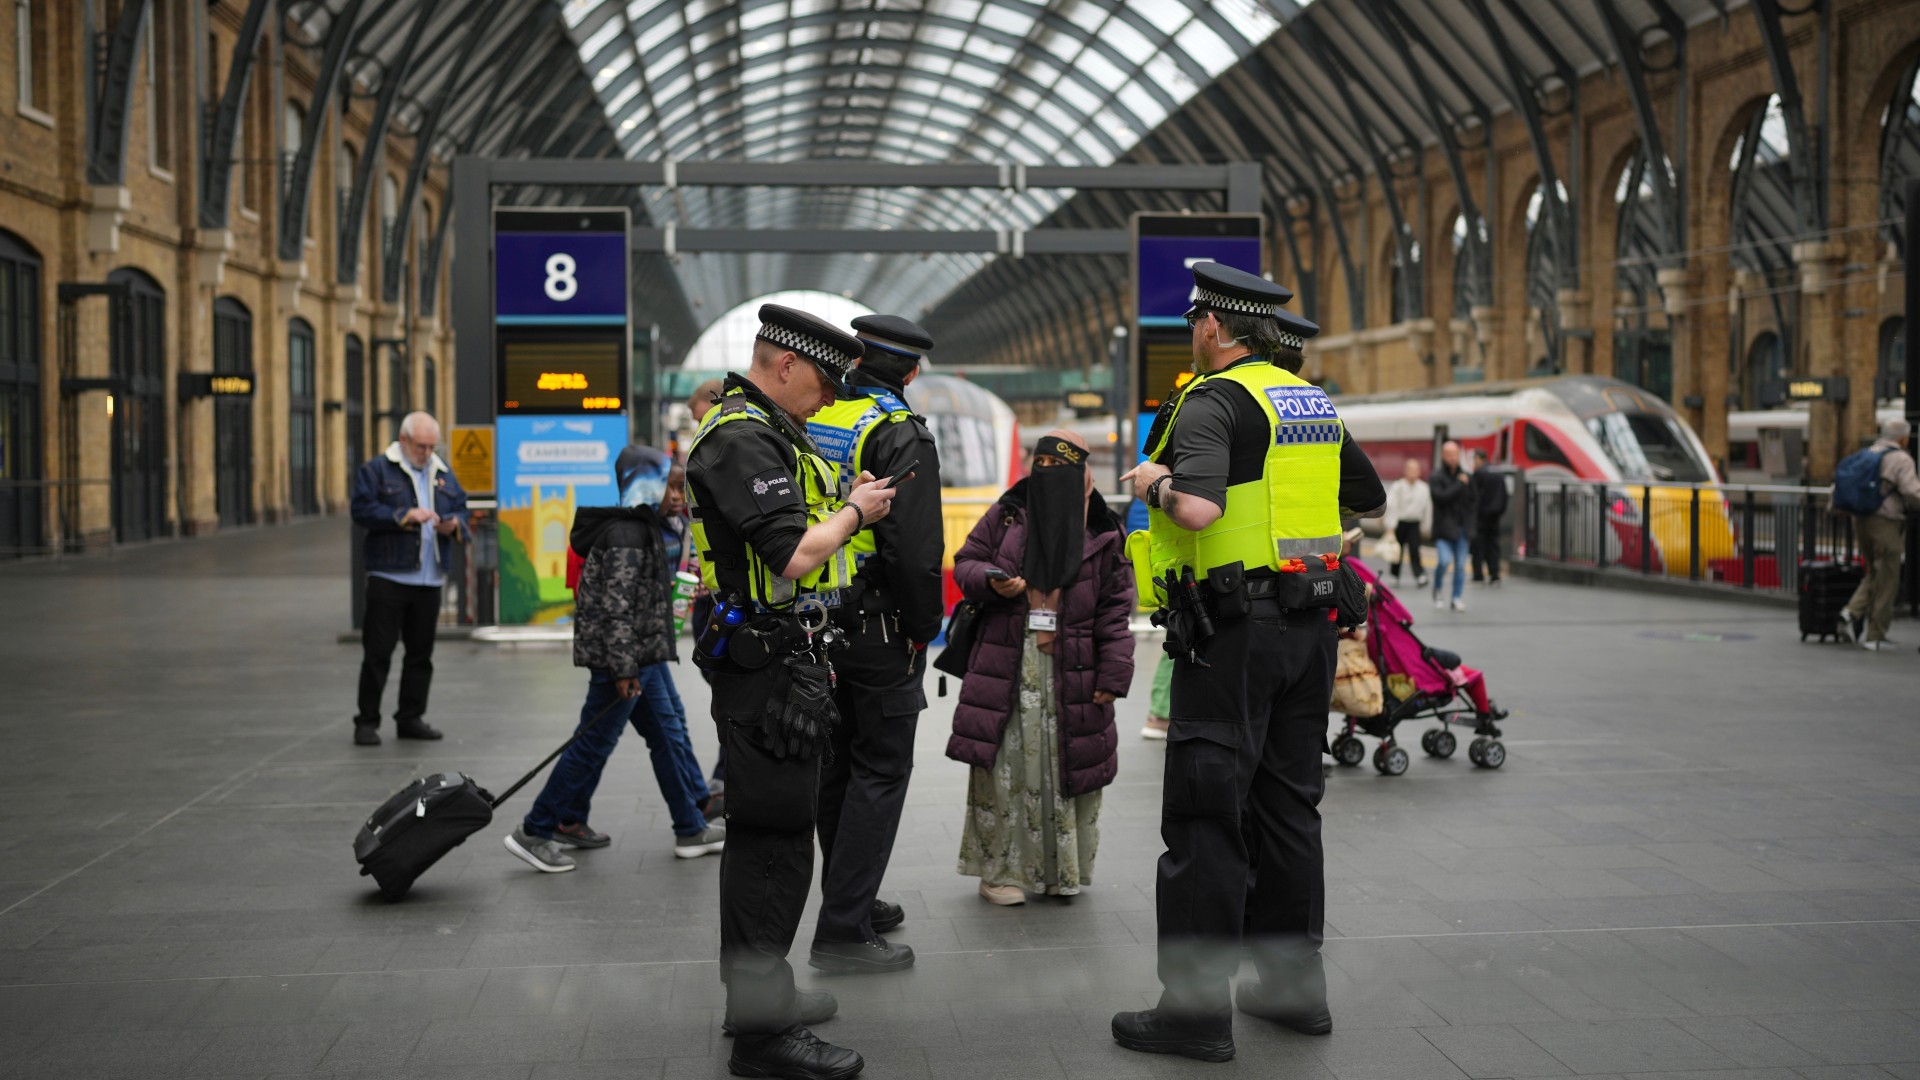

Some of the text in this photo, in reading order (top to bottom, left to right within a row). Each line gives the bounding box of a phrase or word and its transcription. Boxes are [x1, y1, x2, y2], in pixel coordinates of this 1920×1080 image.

[544, 253, 578, 302] 8
[1268, 389, 1324, 398] BRITISH TRANSPORT
[1274, 397, 1335, 417] POLICE
[835, 430, 852, 438] POLICE
[768, 477, 788, 486] POLICE
[1313, 580, 1333, 596] MED
